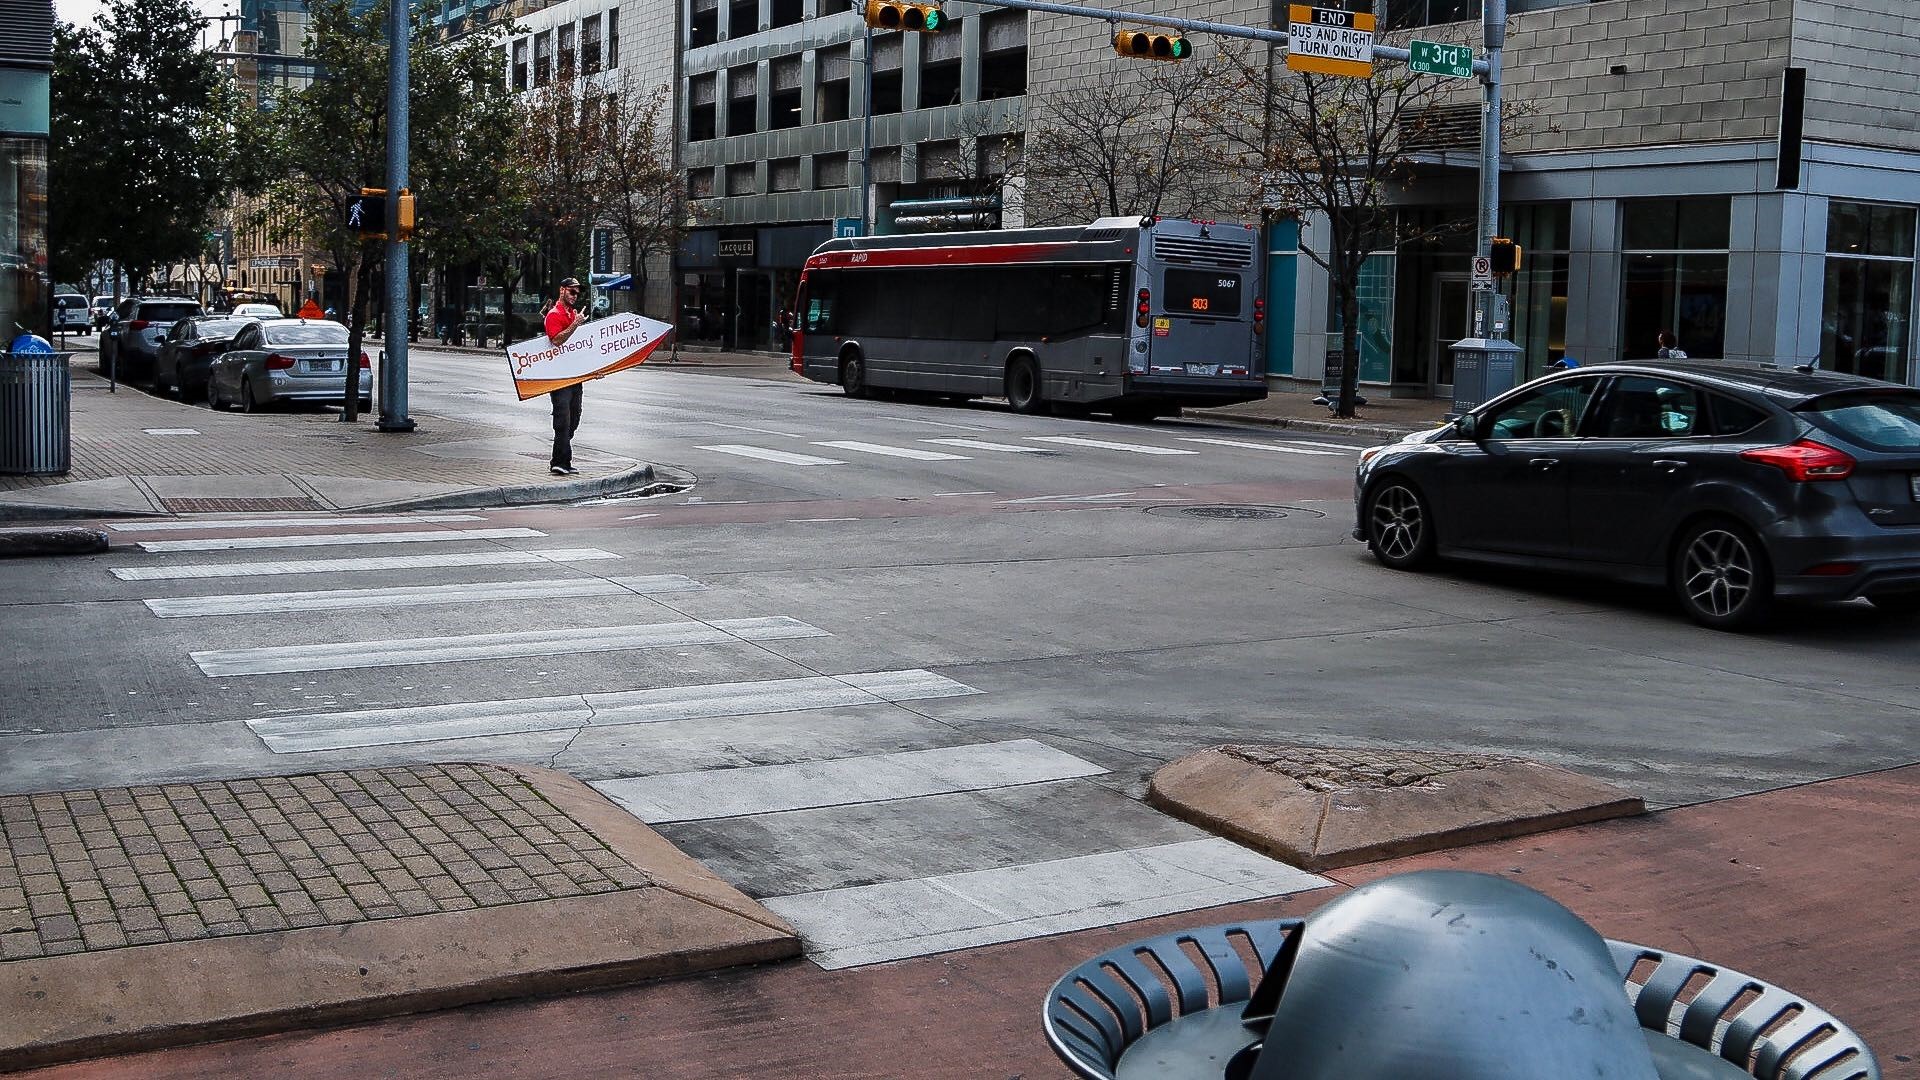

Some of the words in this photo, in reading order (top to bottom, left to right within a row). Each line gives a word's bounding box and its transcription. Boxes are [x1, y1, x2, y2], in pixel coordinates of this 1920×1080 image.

[1320, 11, 1346, 25] END
[1291, 25, 1312, 38] BUS
[1316, 28, 1338, 41] AND
[1342, 31, 1372, 46] RIGHT
[1299, 40, 1329, 55] TURN
[1333, 45, 1362, 59] ONLY
[1421, 47, 1428, 57] W
[1432, 45, 1458, 65] 3rd
[1461, 48, 1471, 58] ST
[1417, 61, 1430, 71] 300
[1452, 66, 1465, 76] 400
[720, 243, 752, 256] LACQUER
[1217, 279, 1236, 288] 5067
[1192, 298, 1209, 310] 803
[600, 317, 642, 339] FITNESS
[600, 331, 649, 356] SPECIALS
